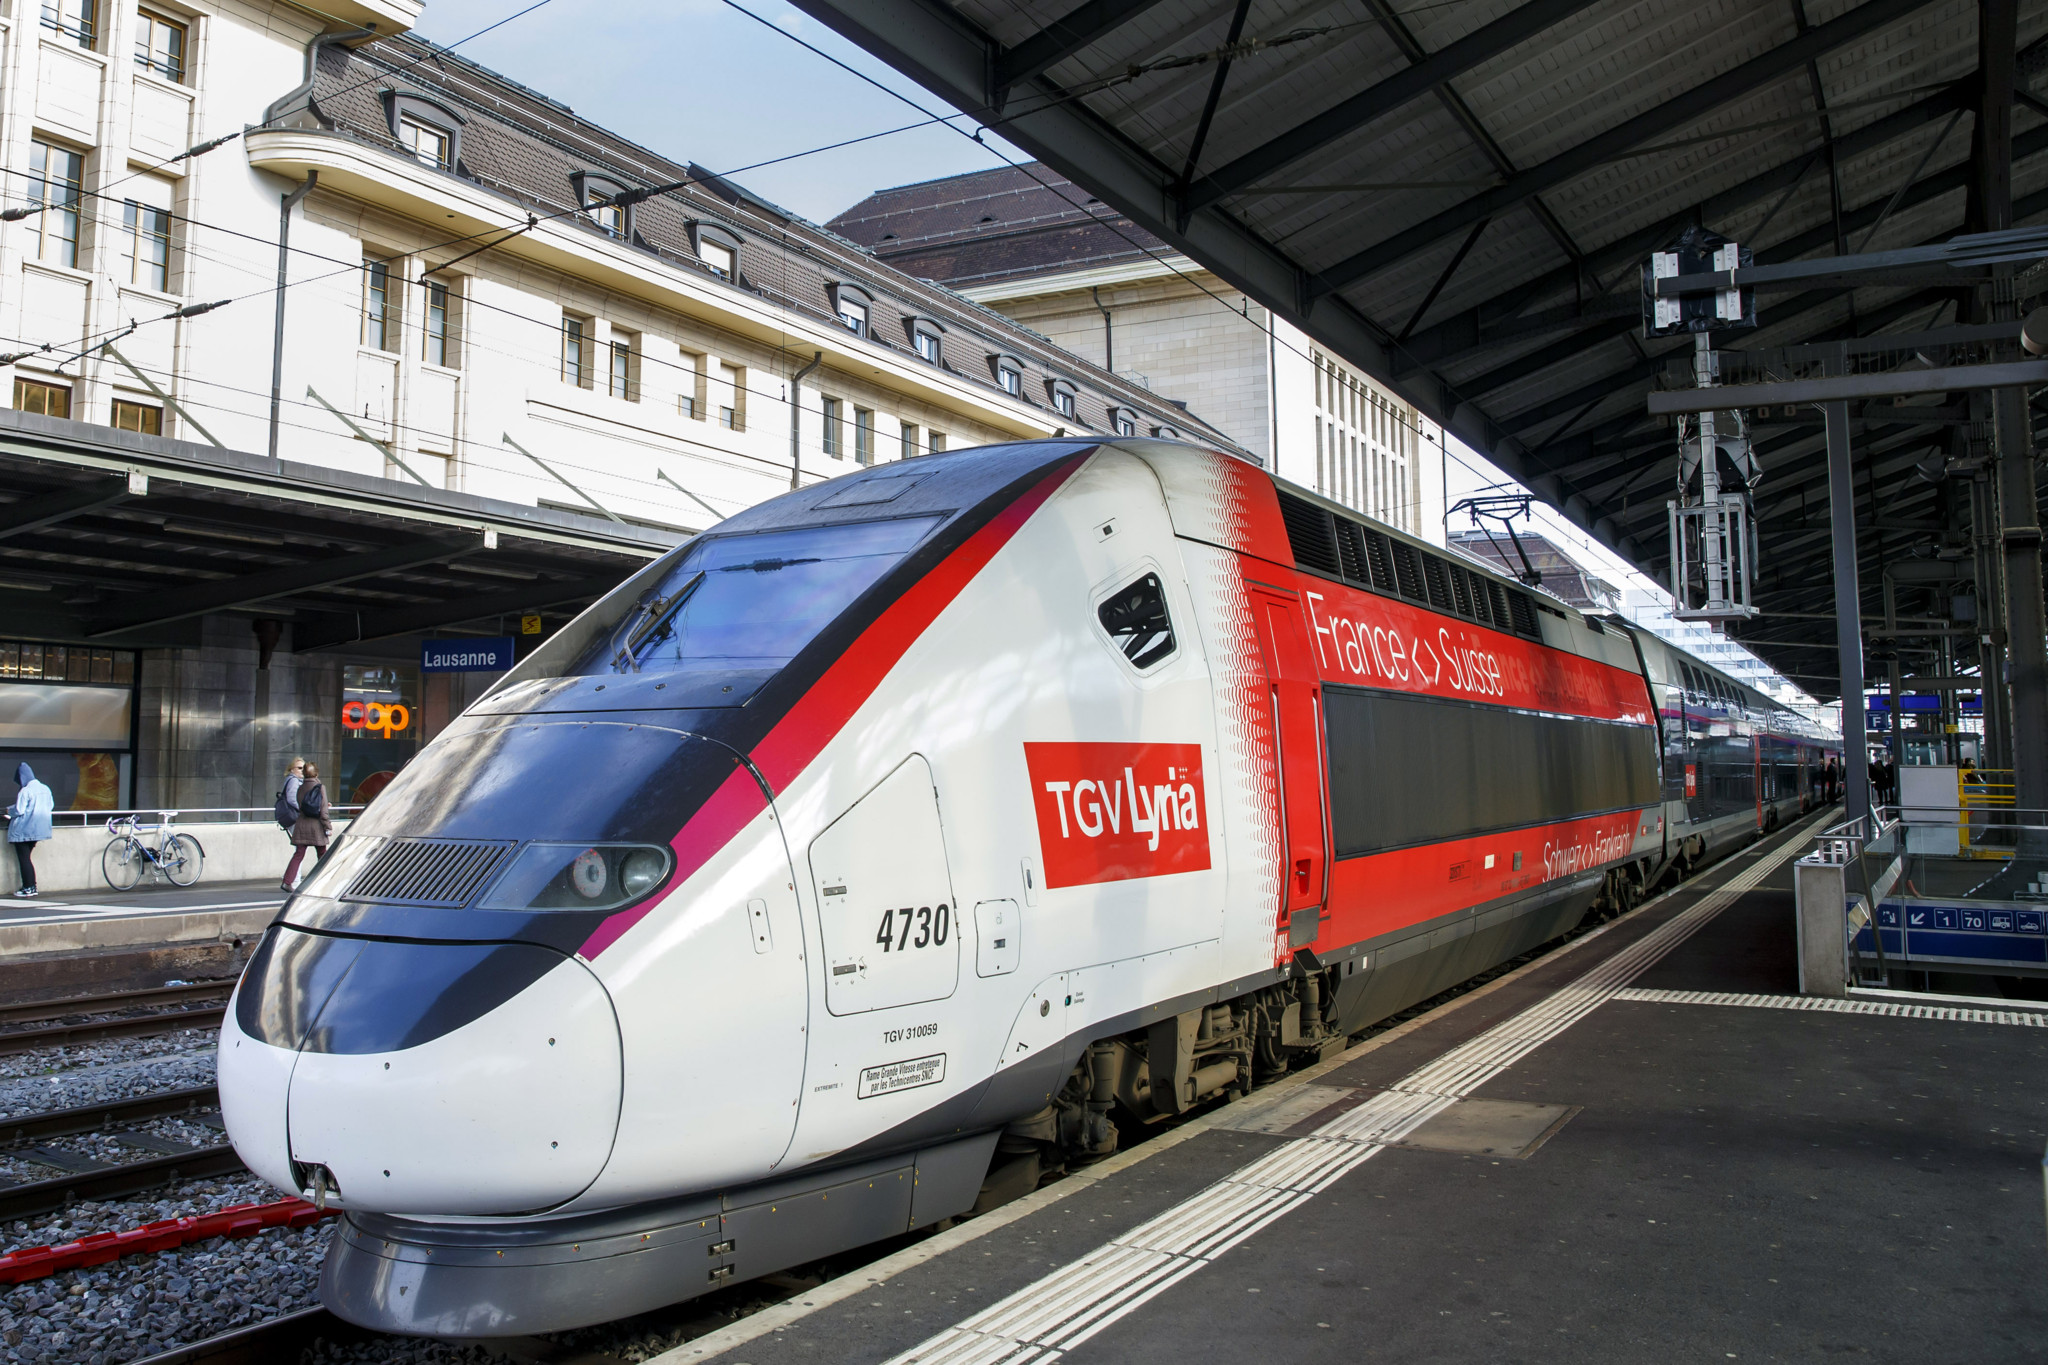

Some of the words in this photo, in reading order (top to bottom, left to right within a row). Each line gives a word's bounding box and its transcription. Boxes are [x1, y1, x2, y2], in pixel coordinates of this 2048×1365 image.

[1306, 590, 1409, 682] France
[1439, 627, 1503, 697] Suisse
[424, 651, 496, 667] Lausanne
[1872, 716, 1881, 728] F
[1045, 779, 1122, 839] TGV
[1124, 767, 1199, 852] Lyria
[1542, 834, 1582, 883] Schweiz
[1594, 824, 1631, 865] Frankreich
[876, 904, 950, 952] 4730
[1943, 916, 1950, 926] 1
[1965, 917, 1982, 928] 70
[883, 1029, 905, 1043] TGV
[905, 1022, 938, 1040] 310059
[866, 1070, 880, 1082] Rame
[881, 1065, 898, 1079] Grande
[899, 1063, 916, 1075] Vitesse
[916, 1059, 940, 1072] entretenue
[870, 1082, 880, 1095] par
[880, 1078, 888, 1090] les
[888, 1074, 921, 1088] Technicentres
[921, 1068, 935, 1082] SNCF
